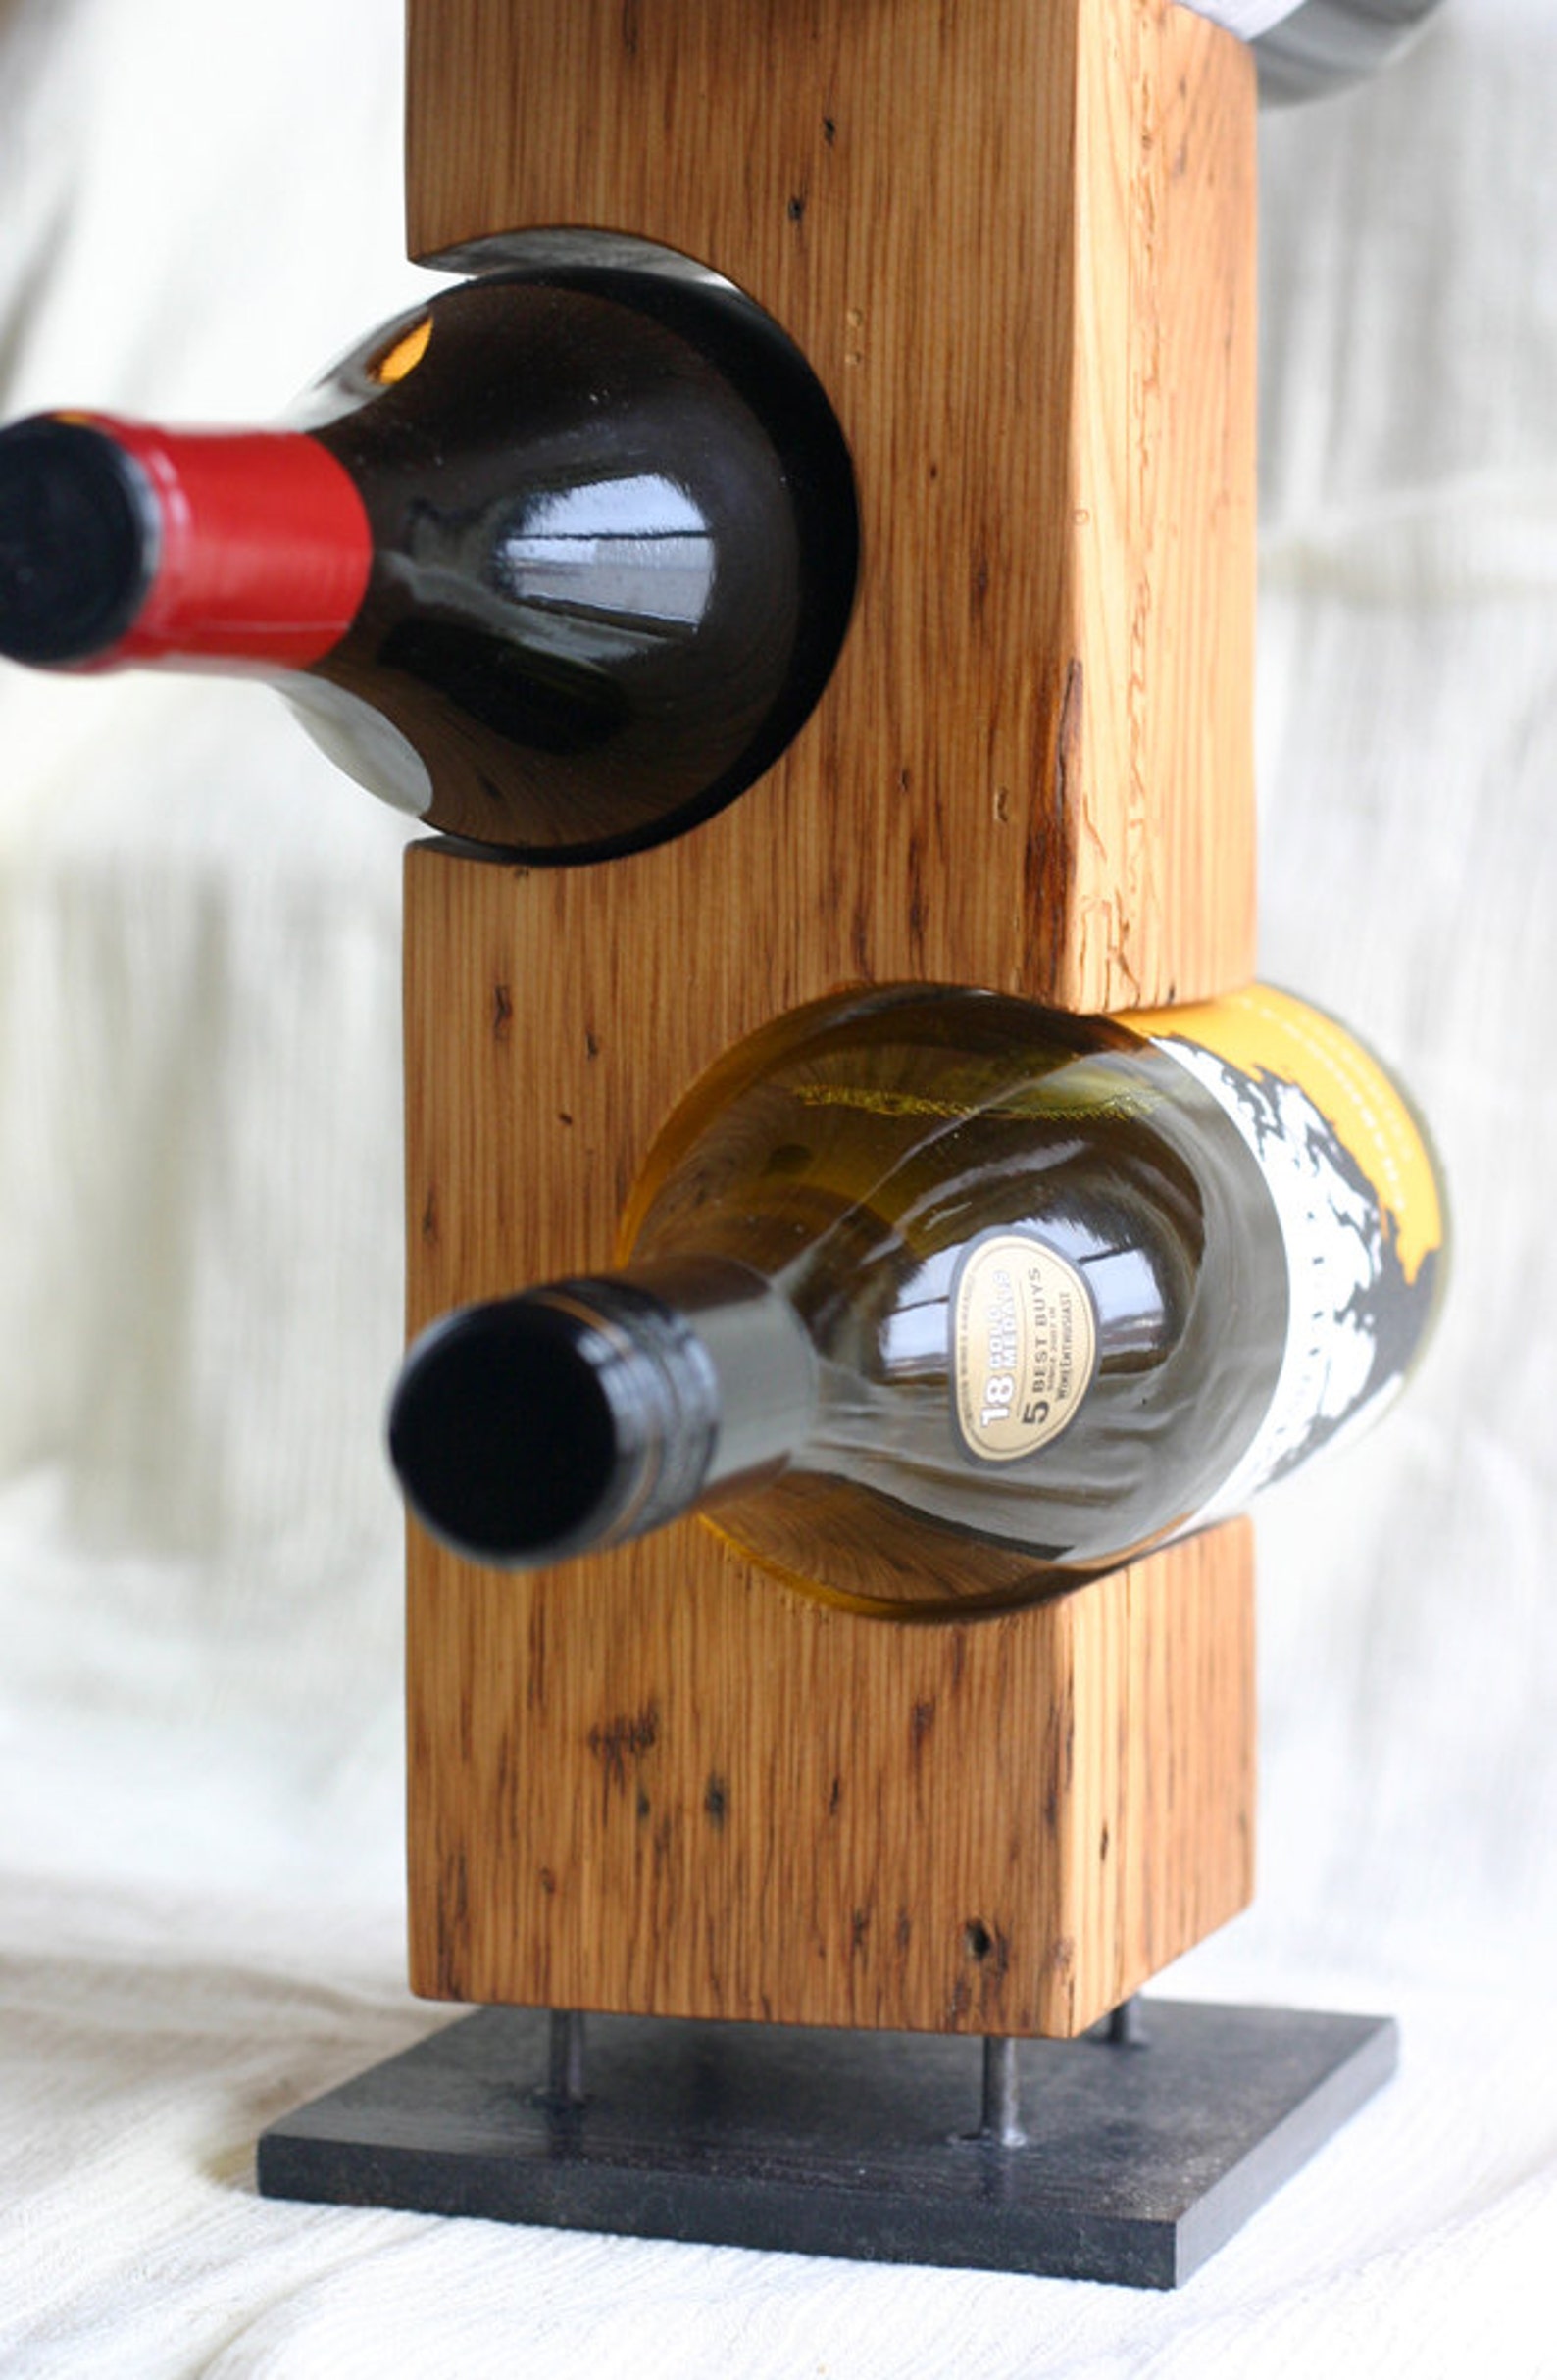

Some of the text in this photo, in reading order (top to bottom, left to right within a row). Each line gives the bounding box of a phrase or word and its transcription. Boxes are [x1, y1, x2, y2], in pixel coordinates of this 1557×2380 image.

[1023, 1267, 1049, 1425] 5 BEST BUYS
[980, 1374, 1016, 1428] 18
